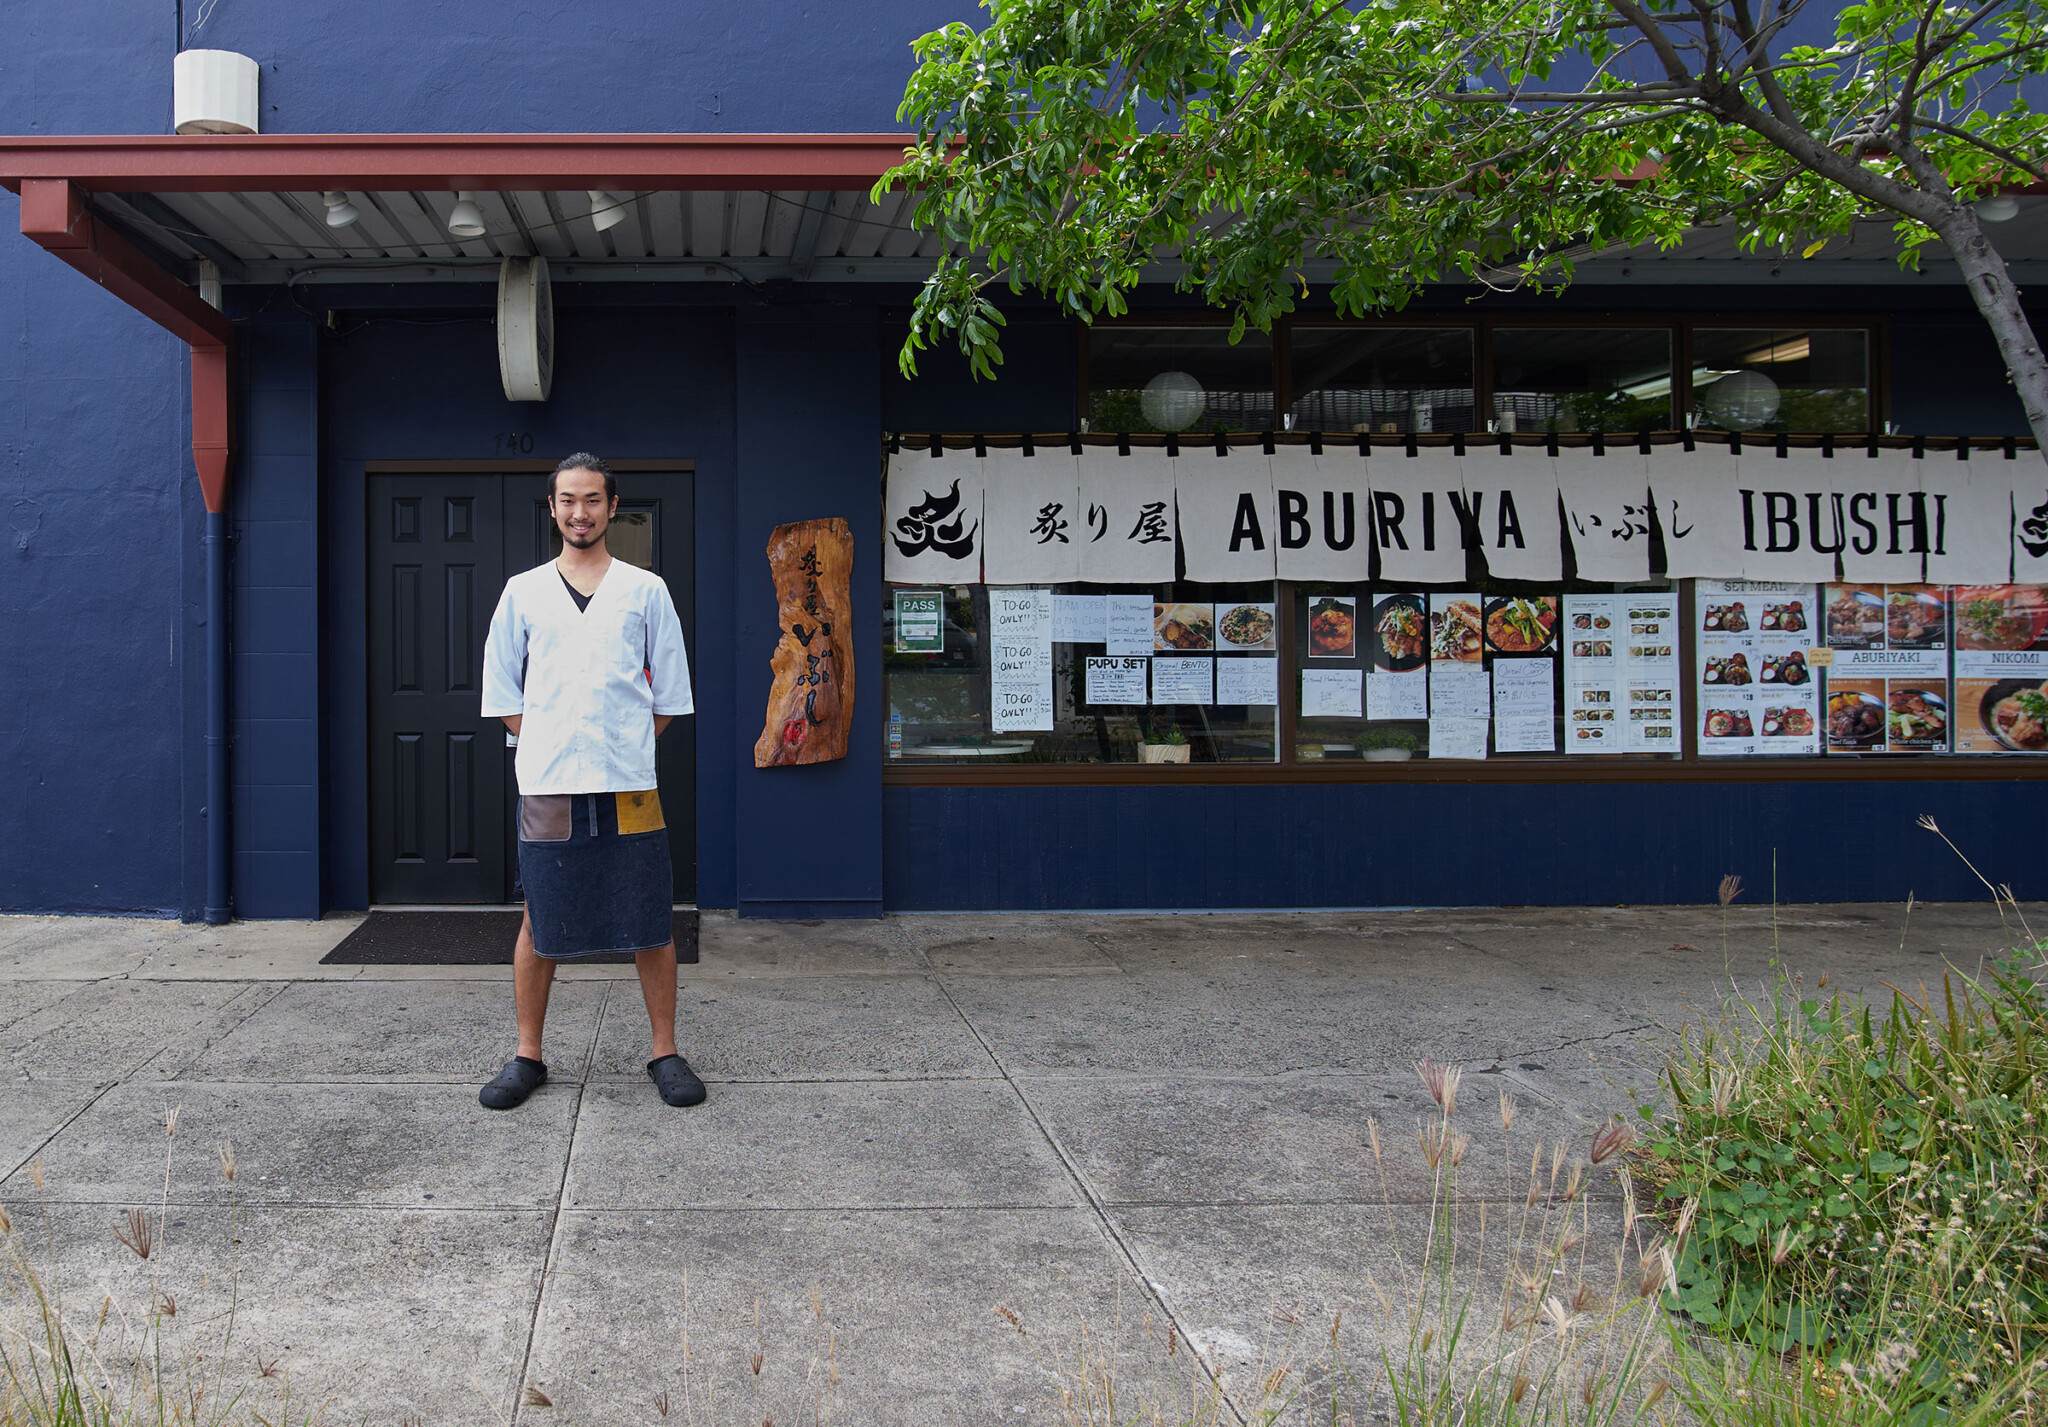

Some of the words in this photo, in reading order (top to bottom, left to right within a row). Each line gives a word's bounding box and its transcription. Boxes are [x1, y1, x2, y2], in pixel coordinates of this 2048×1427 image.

[1228, 489, 1526, 553] ABURIYA
[1738, 488, 1948, 555] IBUSHI
[1724, 581, 1748, 591] SET
[1750, 582, 1787, 591] MEAL
[903, 600, 936, 611] PASS
[1852, 652, 1920, 663] ABURIYAKI
[1991, 653, 2040, 664] NIKOMI
[1088, 658, 1118, 669] PUPU
[1122, 658, 1146, 669] SET
[1181, 659, 1210, 669] BENTO
